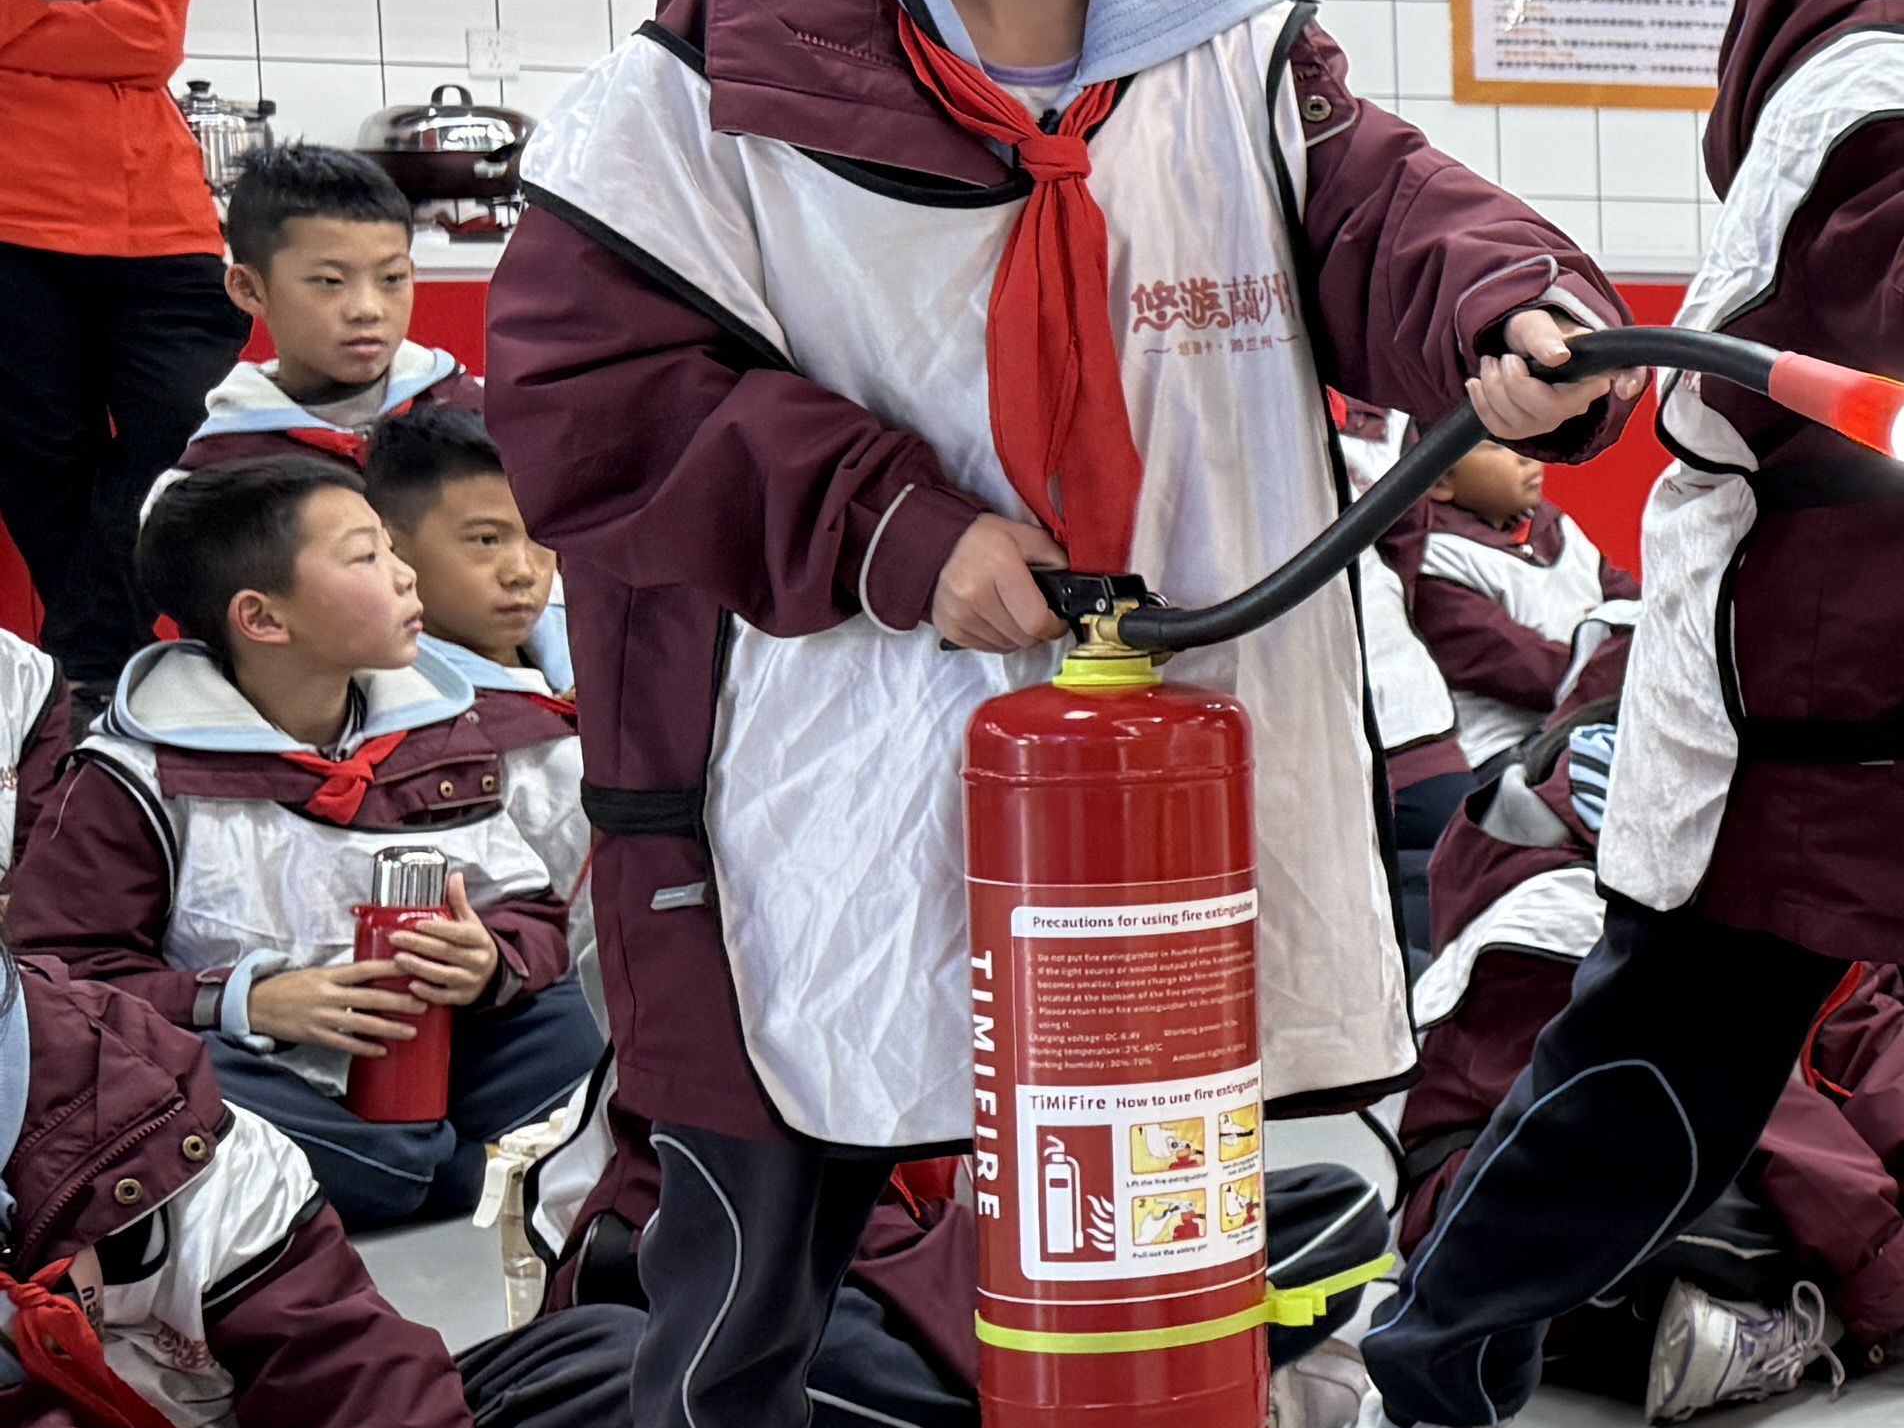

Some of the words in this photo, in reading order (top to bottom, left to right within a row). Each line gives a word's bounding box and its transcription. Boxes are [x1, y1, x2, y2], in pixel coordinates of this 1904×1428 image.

[1033, 916, 1114, 929] Precautions
[1117, 915, 1138, 927] for
[1142, 913, 1179, 927] using
[1182, 910, 1202, 922] fire
[971, 950, 1000, 1219] TIMIFIRE
[1029, 1095, 1106, 1110] TiMiFire
[1116, 1097, 1148, 1109] How
[1151, 1095, 1166, 1107] to
[1169, 1093, 1191, 1104] use
[1194, 1089, 1213, 1101] fire
